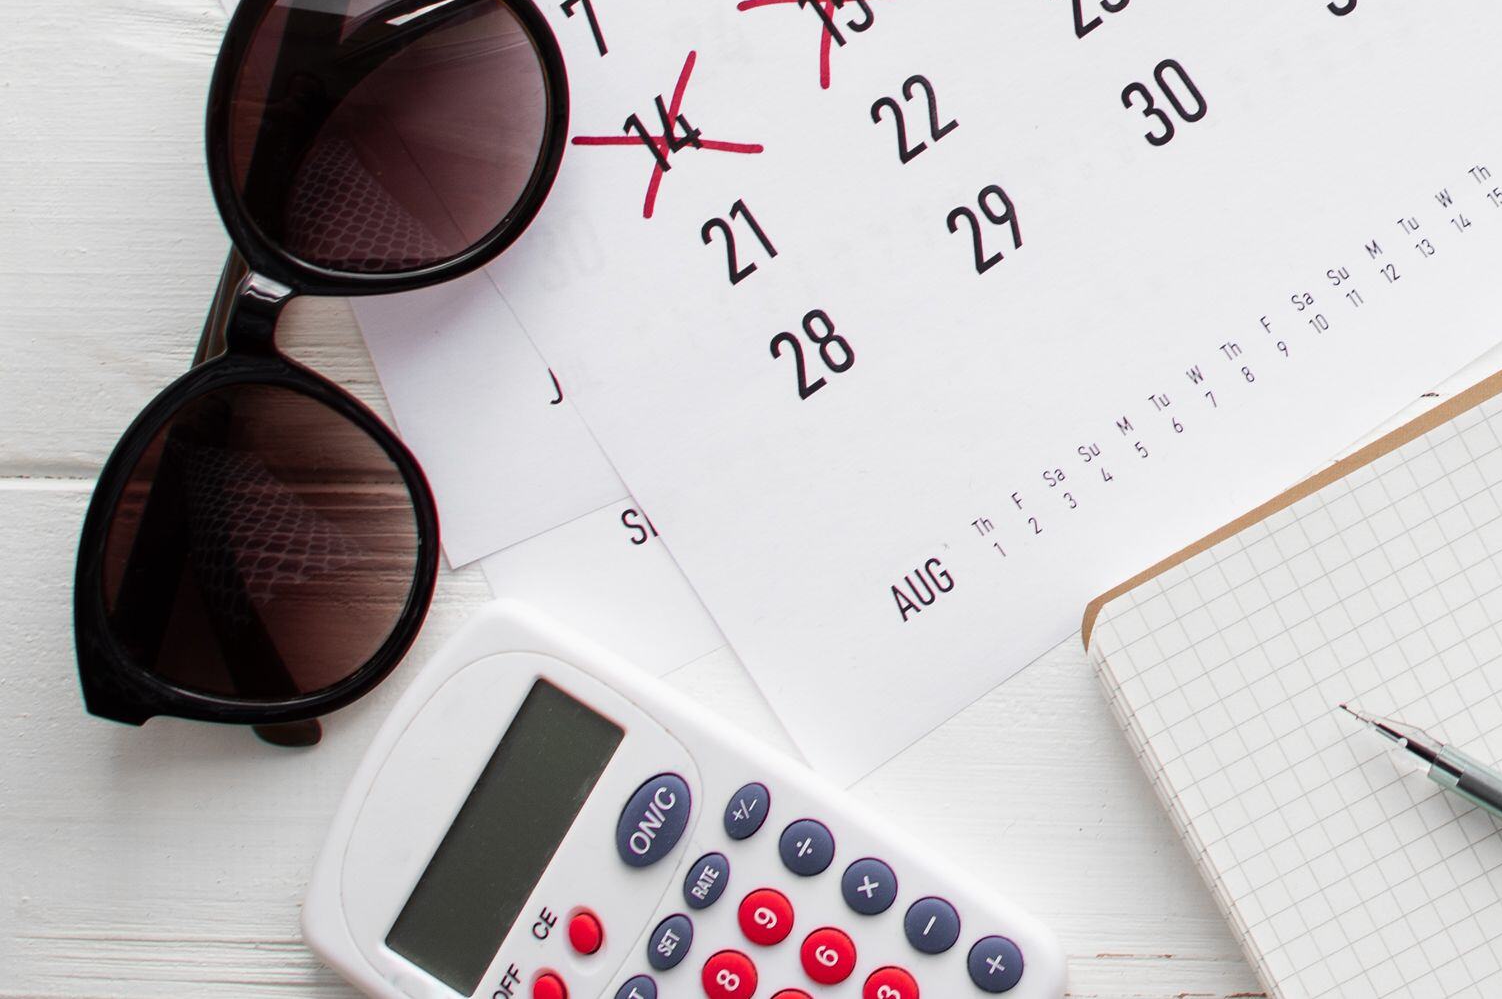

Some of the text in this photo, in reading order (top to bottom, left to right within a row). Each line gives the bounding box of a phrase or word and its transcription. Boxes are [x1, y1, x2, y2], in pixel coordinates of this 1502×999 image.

[623, 95, 701, 172] 14
[701, 199, 777, 285] 21
[871, 75, 959, 164] 22
[770, 310, 854, 400] 28
[947, 185, 1022, 274] 29
[1121, 59, 1207, 146] 30
[970, 517, 995, 537] Th
[1010, 491, 1023, 511] F
[1042, 468, 1066, 488] Sa
[1077, 442, 1101, 463] Su
[1115, 415, 1135, 437] M
[1147, 393, 1171, 412] Tu
[1185, 364, 1204, 386] W
[1218, 341, 1243, 361] Th
[1259, 315, 1272, 334] F
[1290, 292, 1315, 312] Sa
[1325, 266, 1351, 287] Su
[1364, 238, 1384, 260] M
[1396, 216, 1420, 235] Tu
[1434, 187, 1454, 209] W
[1467, 164, 1492, 185] Th
[992, 541, 1007, 558] 1
[1027, 516, 1044, 536] 2
[1062, 492, 1078, 510] 3
[1100, 467, 1114, 483] 4
[1133, 440, 1149, 459] 5
[1171, 416, 1184, 434] 6
[1204, 390, 1218, 409] 7
[1240, 365, 1256, 384] 8
[1276, 340, 1289, 358] 9
[1308, 313, 1330, 334] 10
[1345, 288, 1364, 308] 11
[1379, 263, 1401, 284] 12
[1414, 238, 1436, 259] 13
[1450, 213, 1472, 233] 14
[891, 558, 954, 622] AUG
[629, 787, 677, 855] ON/C
[691, 865, 720, 900] RATE
[531, 906, 558, 941] CE
[656, 928, 681, 957] SET
[753, 907, 778, 929] 9
[716, 969, 741, 992] 8
[815, 945, 839, 967] 6
